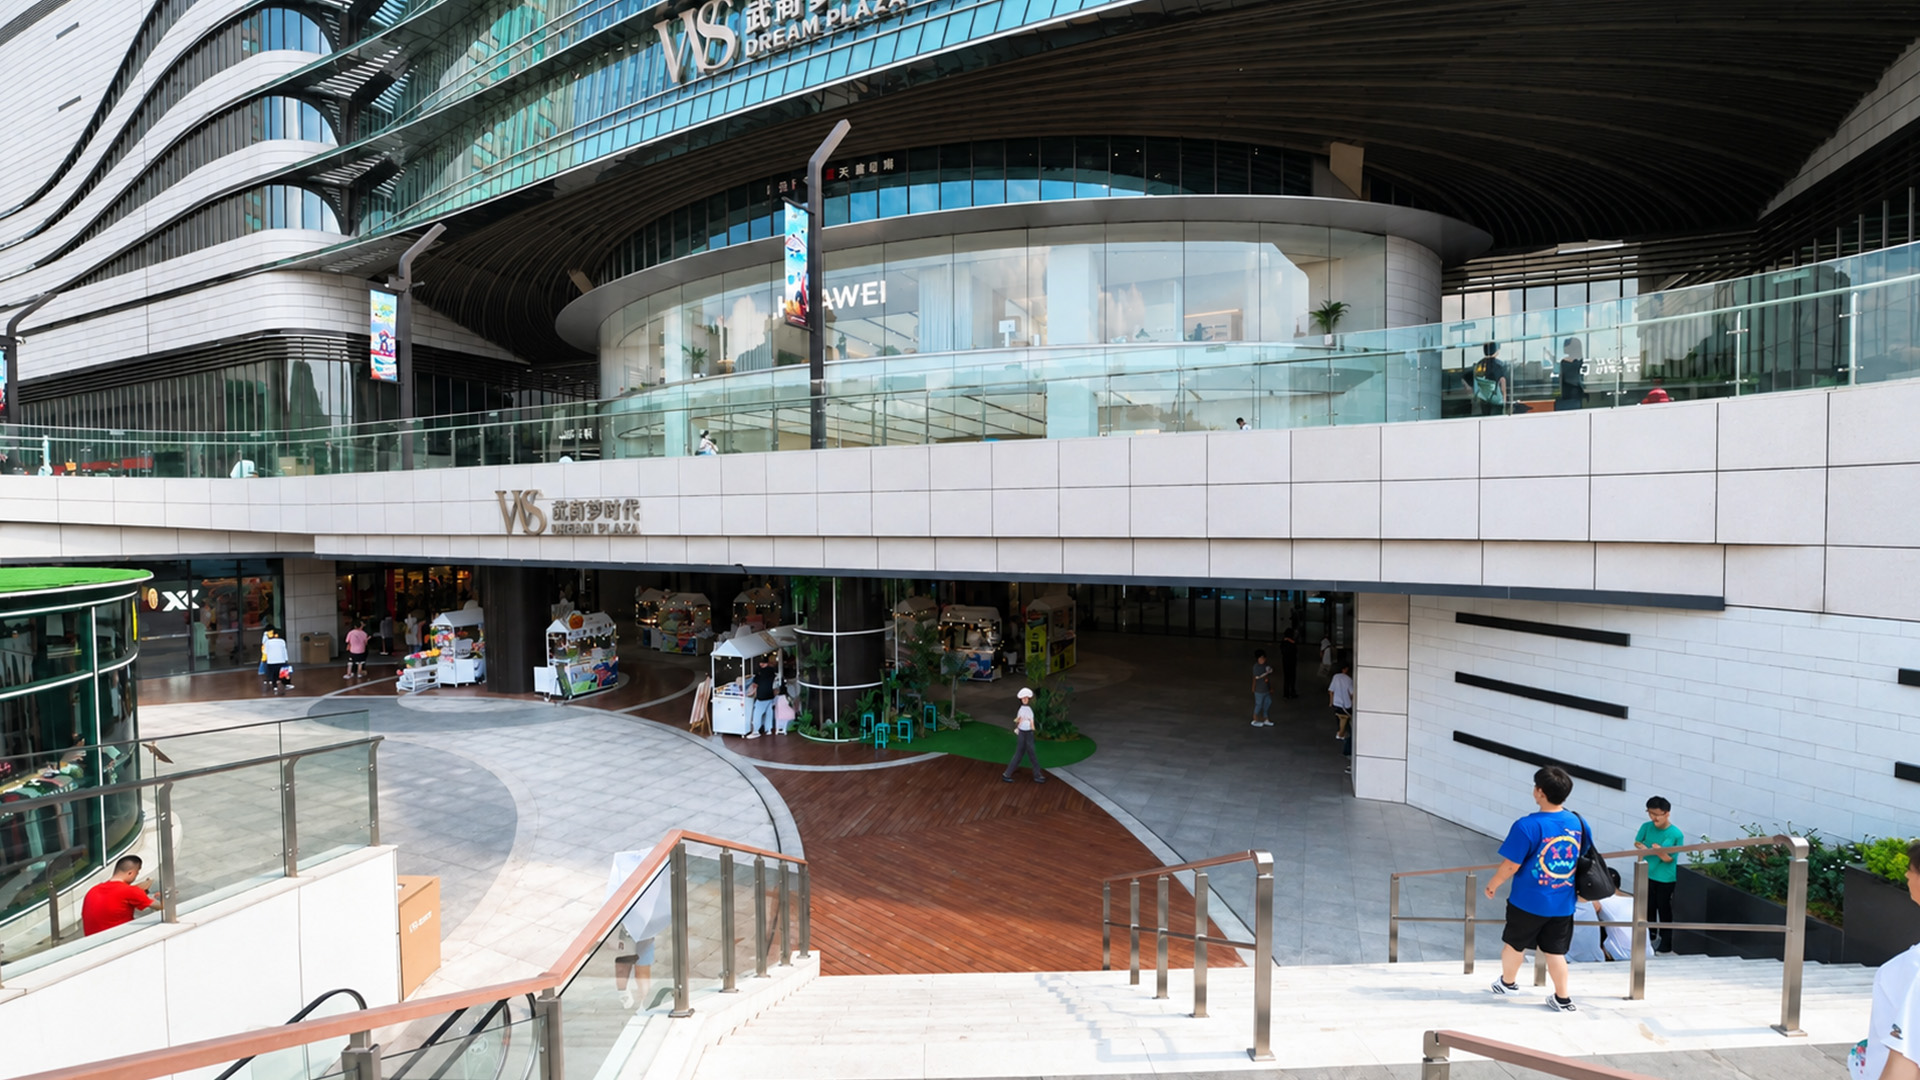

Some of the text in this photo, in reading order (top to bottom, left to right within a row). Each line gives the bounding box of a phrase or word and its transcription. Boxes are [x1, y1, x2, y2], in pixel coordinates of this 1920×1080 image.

[745, 15, 820, 58] DREAM
[777, 280, 887, 319] HAWEI
[597, 522, 641, 535] PLAZA
